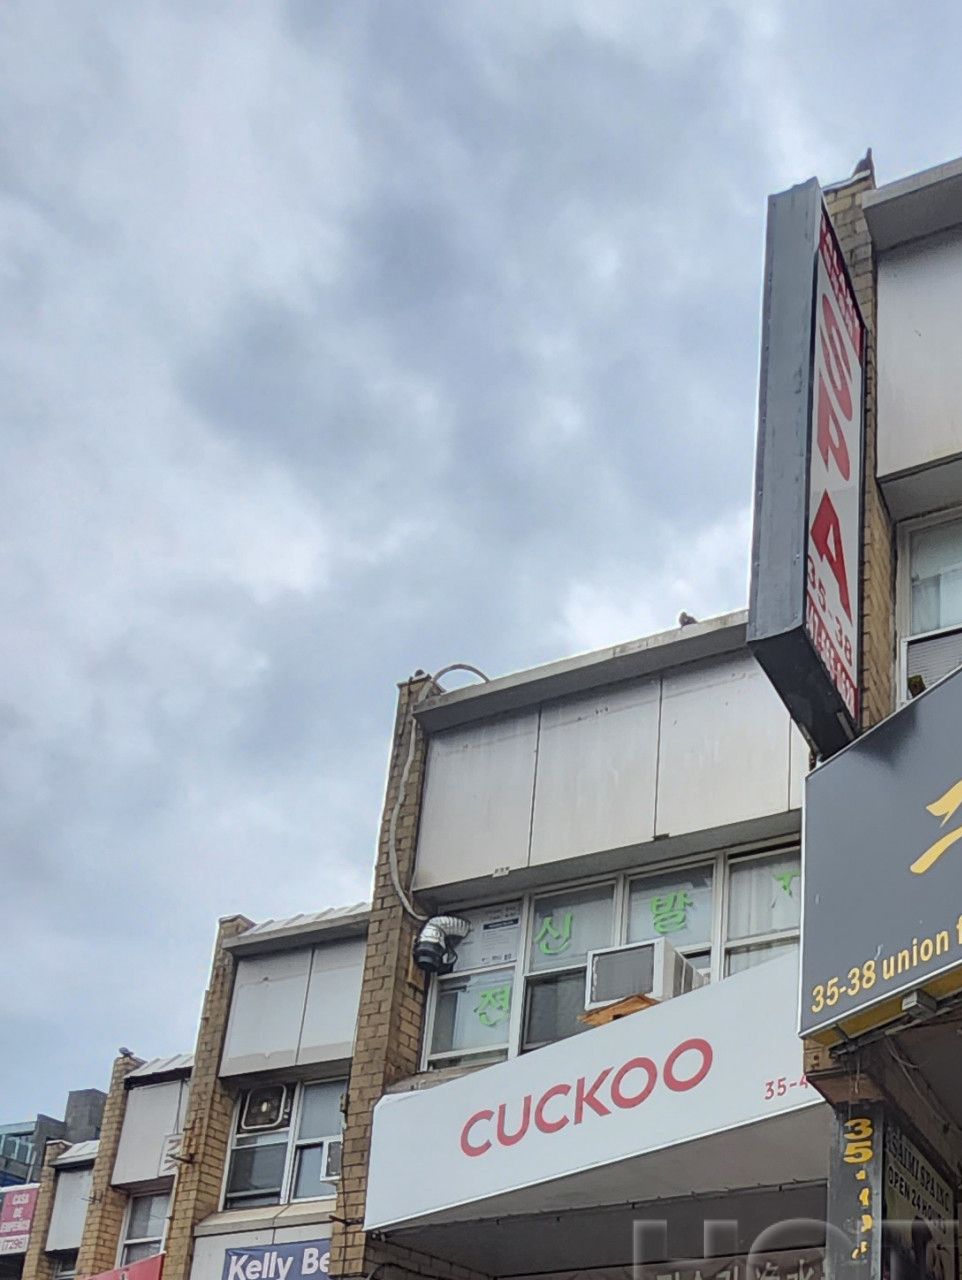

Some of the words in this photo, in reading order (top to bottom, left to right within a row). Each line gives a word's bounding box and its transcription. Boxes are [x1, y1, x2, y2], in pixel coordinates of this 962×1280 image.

[808, 292, 855, 627] SPA
[811, 960, 876, 1014] 35-38
[882, 930, 949, 981] union
[460, 1037, 714, 1158] CUCKOO
[887, 1165, 911, 1202] OPEN
[911, 1188, 922, 1213] 24
